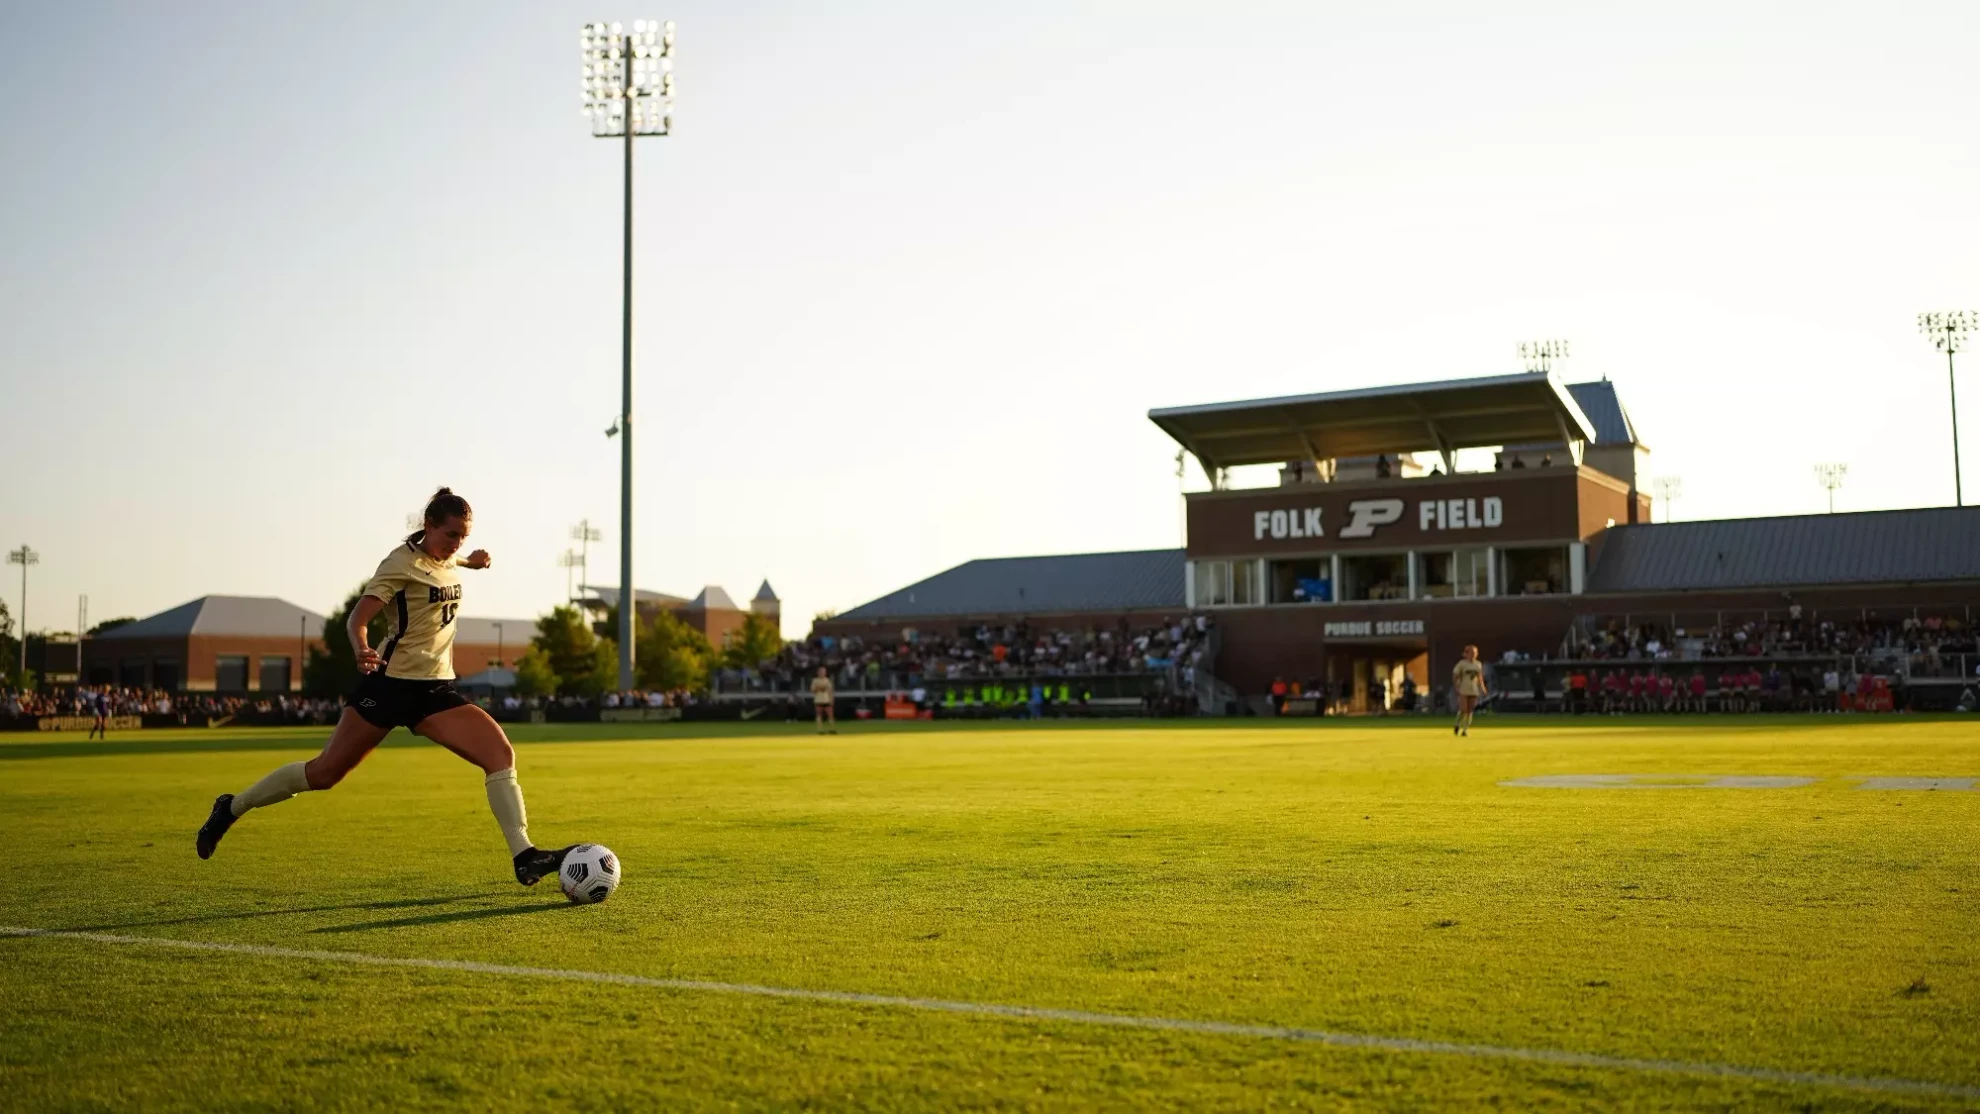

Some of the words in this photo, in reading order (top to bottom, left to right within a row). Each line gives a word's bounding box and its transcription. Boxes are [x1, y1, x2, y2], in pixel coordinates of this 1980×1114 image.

[1254, 507, 1324, 540] FOLK
[1339, 499, 1404, 538] P
[1419, 497, 1503, 531] FIELD
[1324, 621, 1372, 636] PURDUE
[1376, 620, 1424, 635] SOCCER
